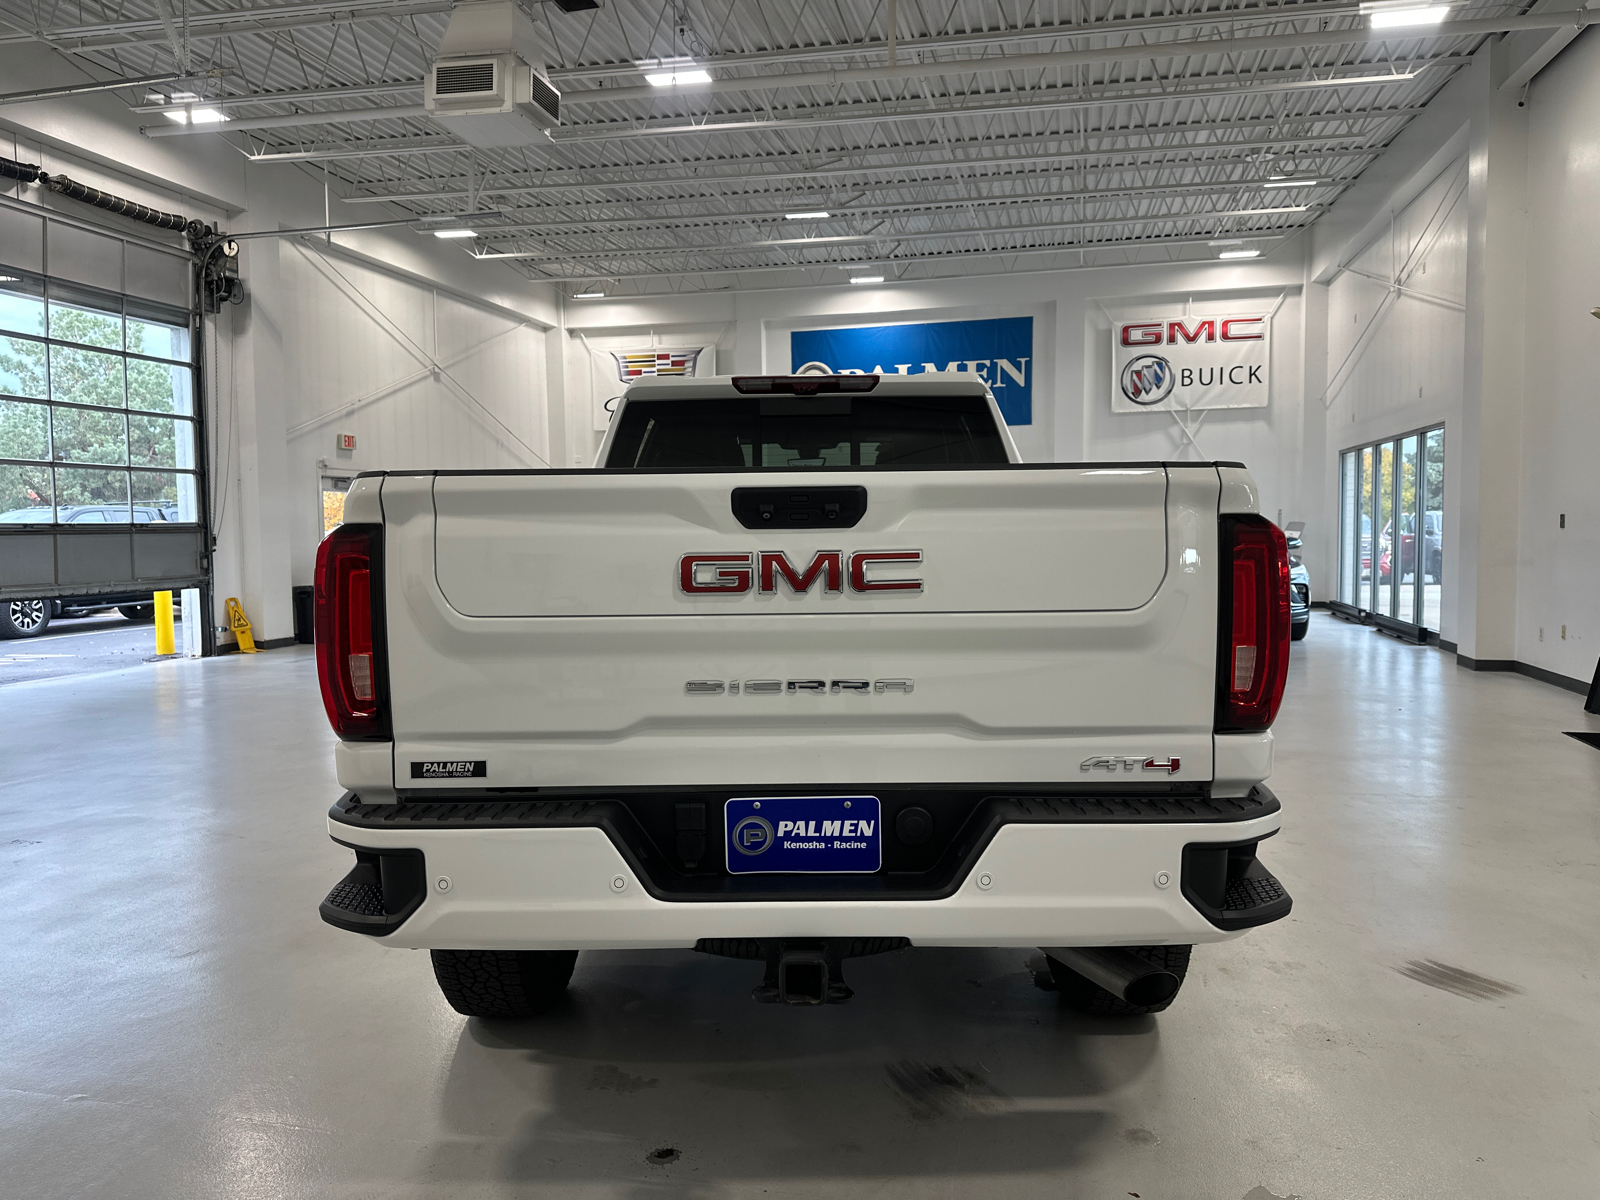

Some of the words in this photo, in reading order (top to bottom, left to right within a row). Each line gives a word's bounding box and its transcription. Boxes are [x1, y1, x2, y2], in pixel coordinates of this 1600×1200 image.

[1120, 316, 1265, 348] GMC
[1181, 365, 1263, 387] BUICK
[678, 549, 924, 595] GMC
[684, 678, 915, 696] SIERRA
[422, 762, 475, 773] PALMEN
[1080, 756, 1181, 775] AT4
[776, 820, 875, 837] PALMEN
[783, 840, 825, 849] Kenosha
[833, 840, 867, 849] Racine
